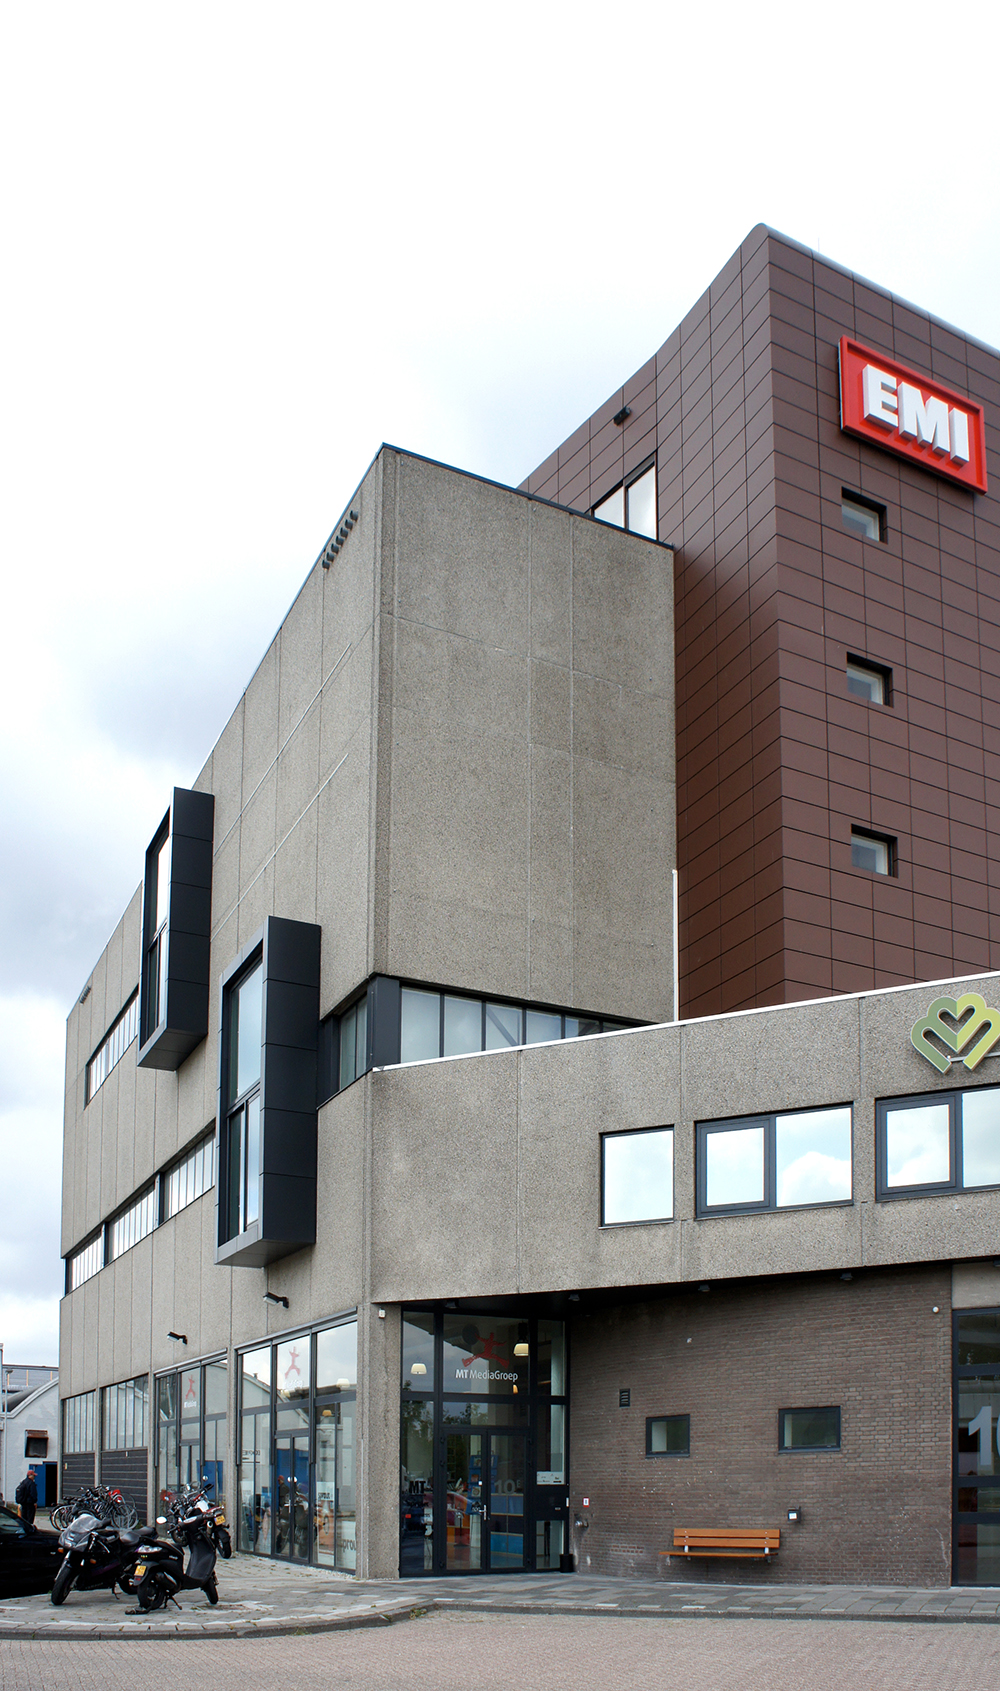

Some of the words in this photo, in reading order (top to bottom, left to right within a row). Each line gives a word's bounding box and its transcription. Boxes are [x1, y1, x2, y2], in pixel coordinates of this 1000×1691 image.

[862, 364, 969, 463] EMI
[455, 1369, 469, 1379] MT
[469, 1370, 519, 1382] MediaGroep
[968, 1405, 1000, 1466] 1
[409, 1480, 426, 1494] MT
